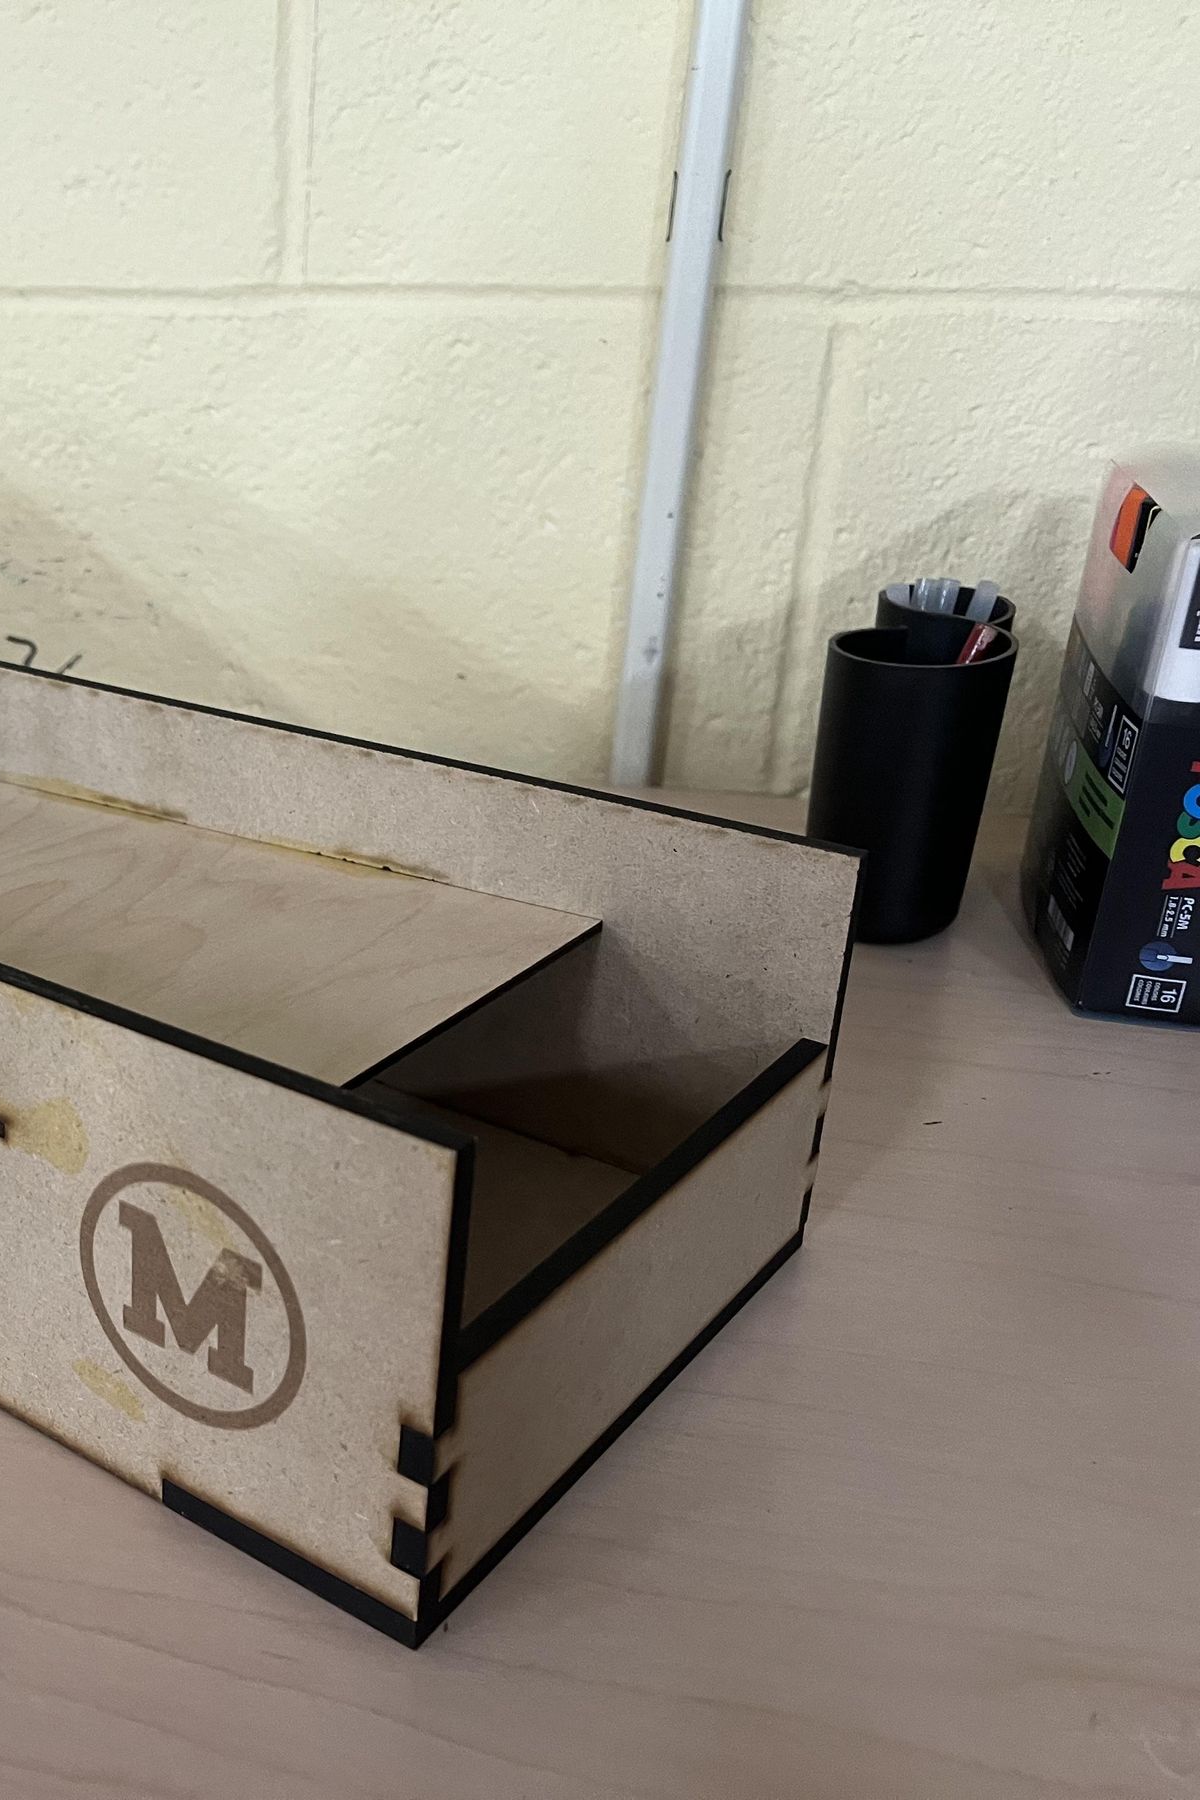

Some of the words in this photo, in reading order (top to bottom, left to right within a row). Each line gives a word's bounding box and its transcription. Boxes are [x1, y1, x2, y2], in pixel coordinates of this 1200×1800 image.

[1176, 897, 1195, 930] PC-5M
[1160, 923, 1169, 937] mm
[1160, 988, 1178, 1003] 16
[119, 1200, 262, 1395] M
